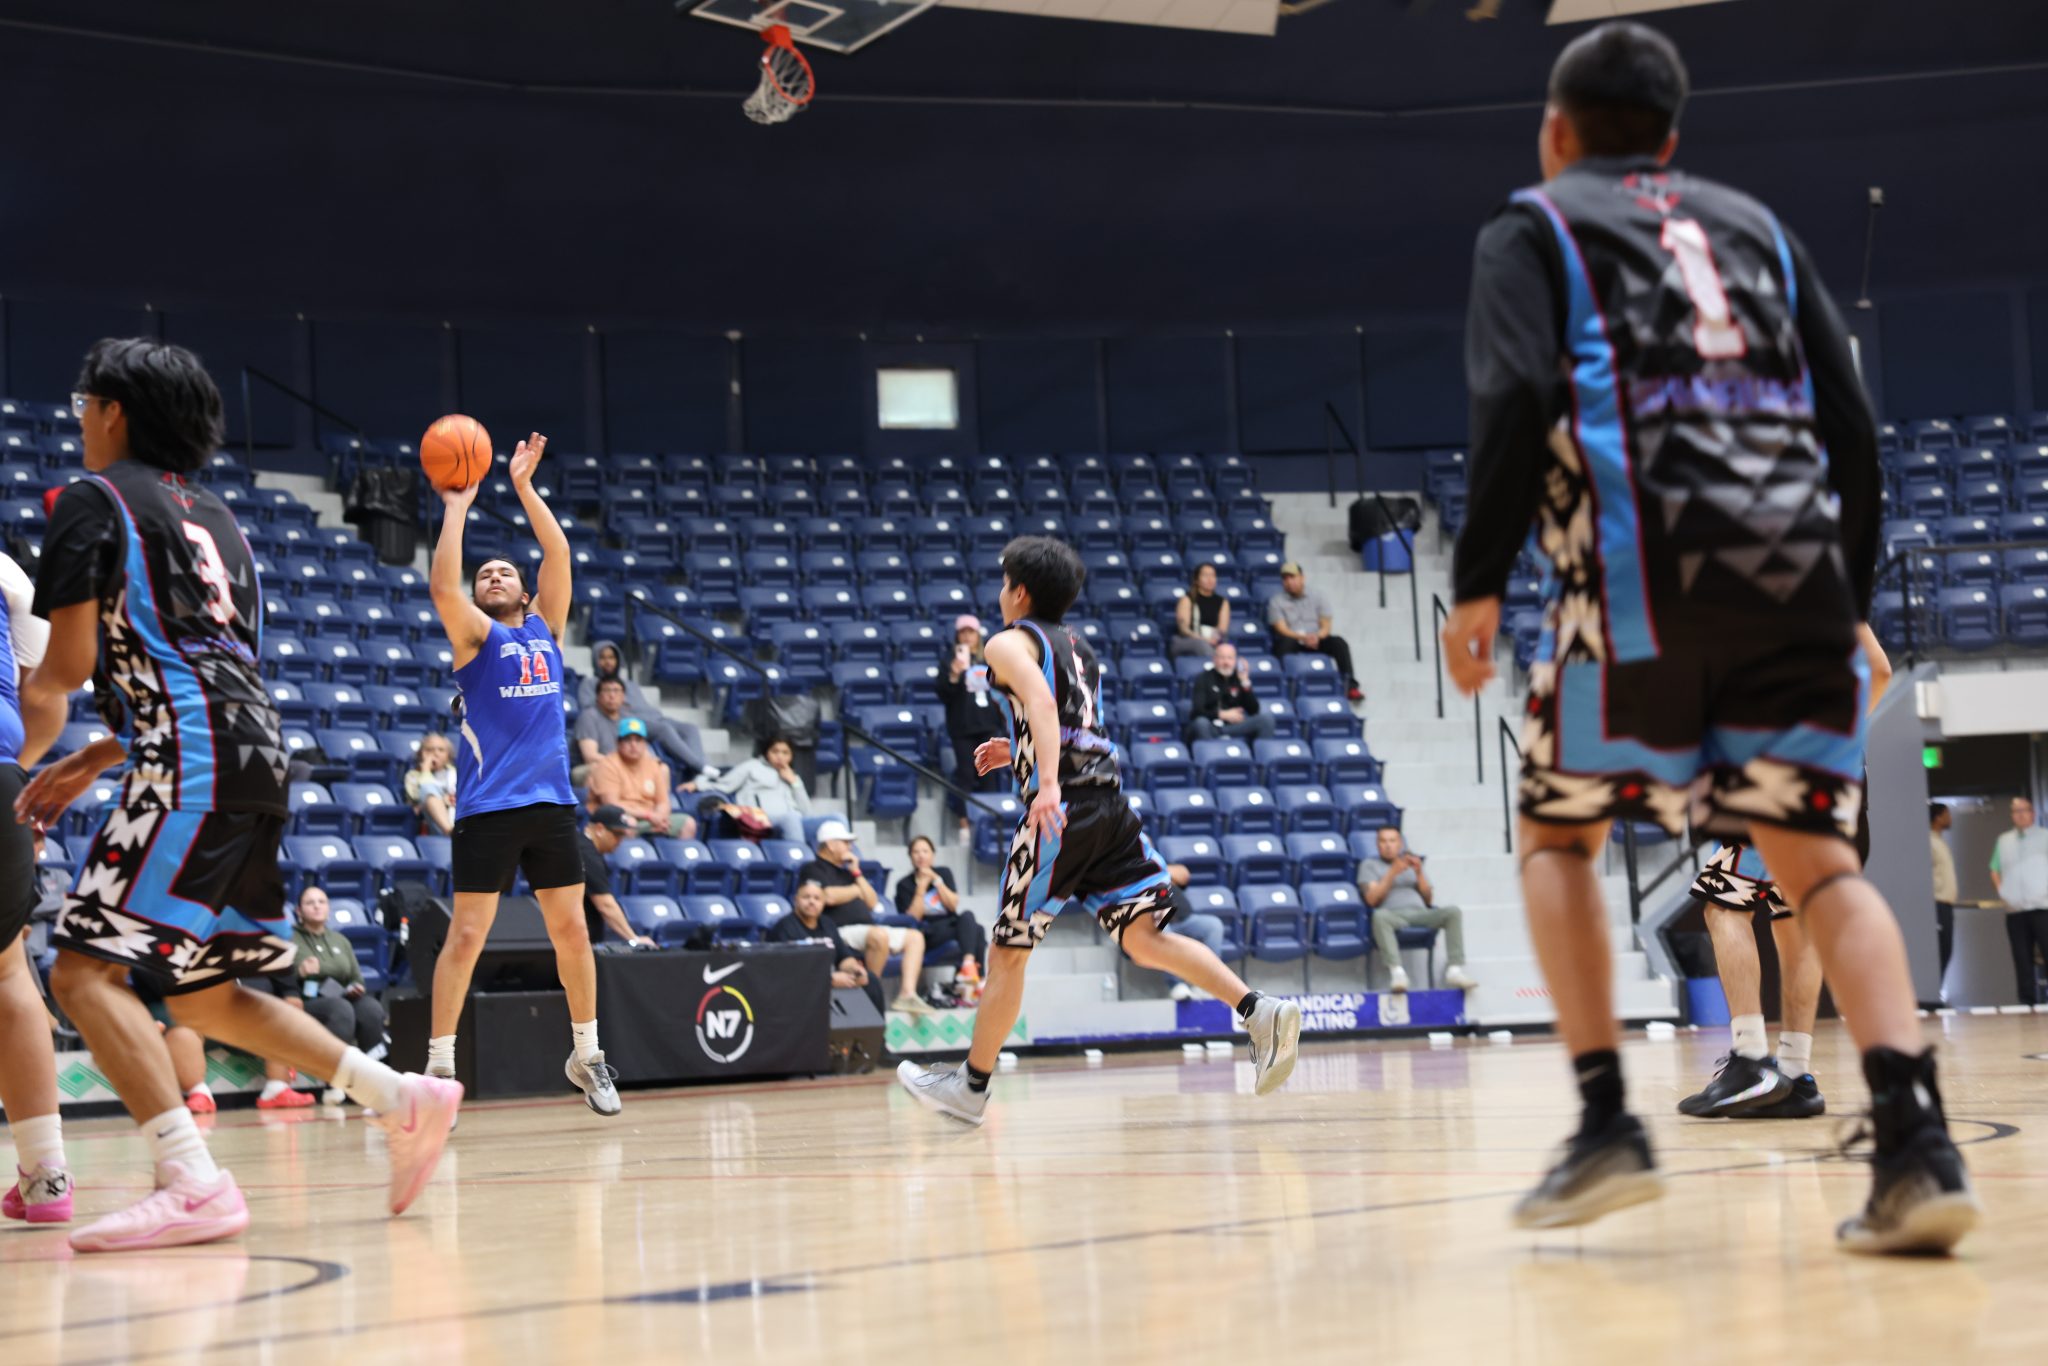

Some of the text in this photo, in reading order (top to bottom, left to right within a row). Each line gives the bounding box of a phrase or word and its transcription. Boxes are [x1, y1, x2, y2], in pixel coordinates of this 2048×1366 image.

[1659, 217, 1746, 359] 1
[181, 520, 236, 624] 3
[519, 651, 550, 685] 14
[1284, 993, 1366, 1012] ANDICAP
[706, 1009, 741, 1039] N7
[1300, 1010, 1358, 1031] EATING
